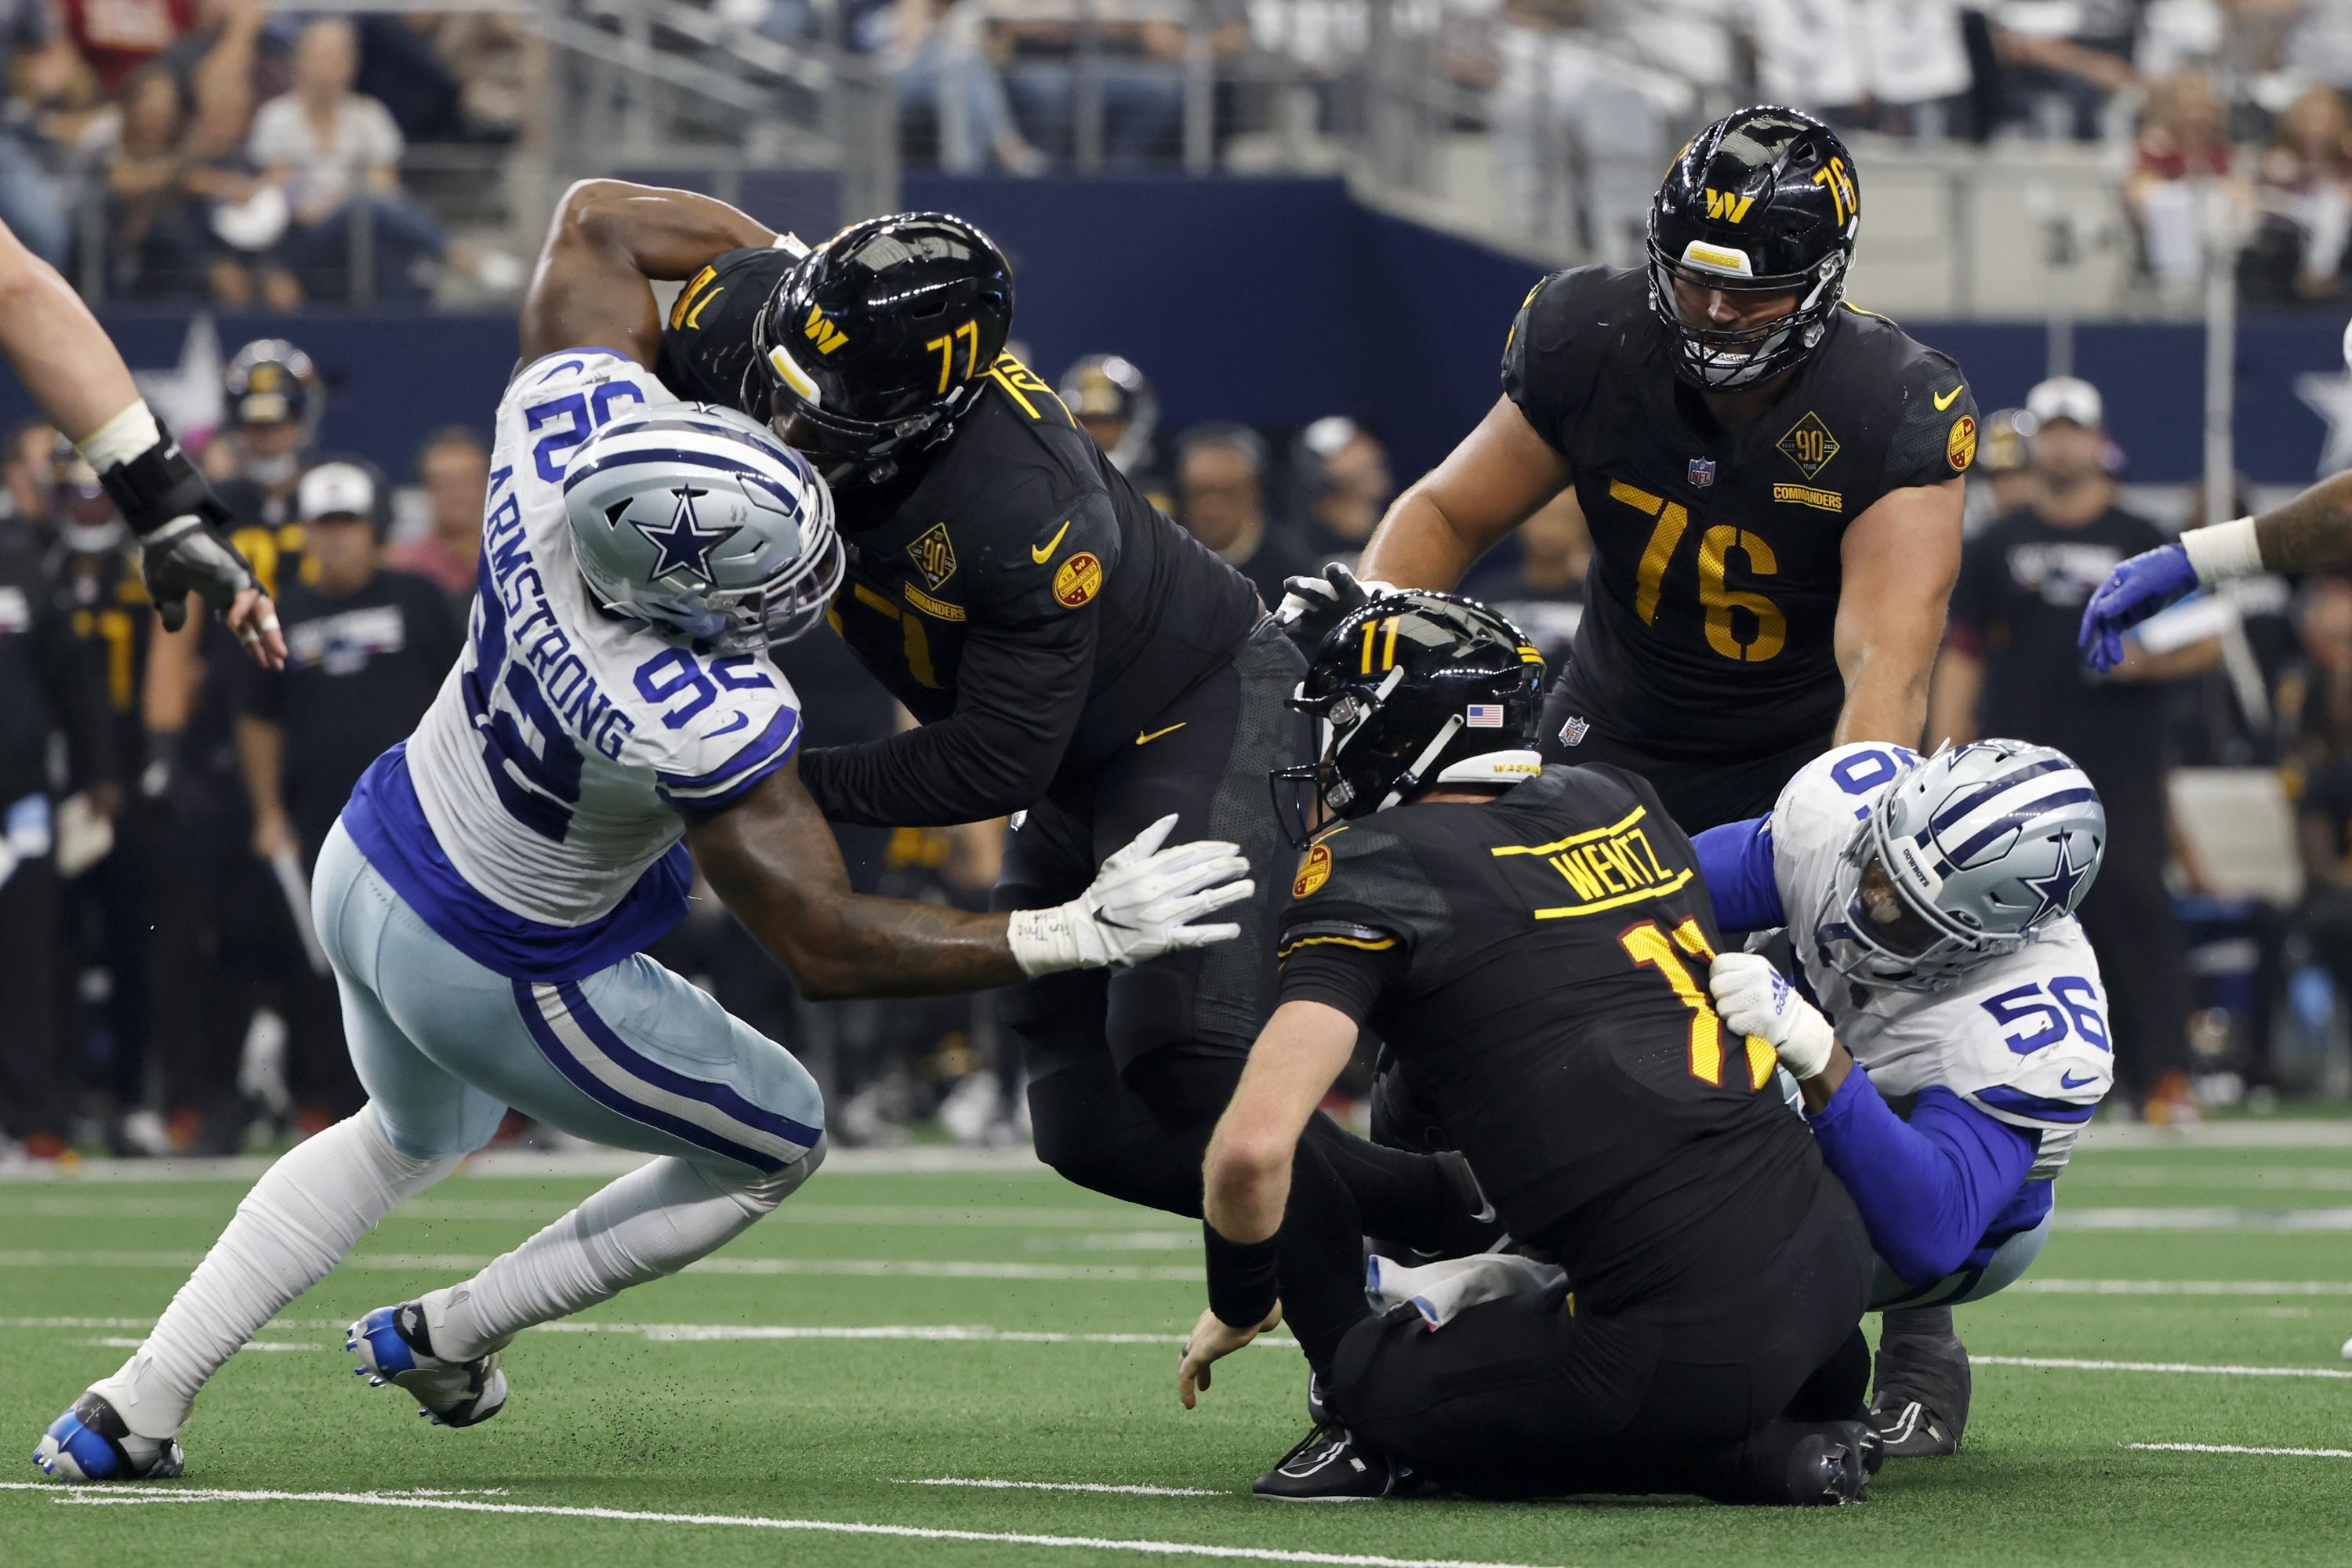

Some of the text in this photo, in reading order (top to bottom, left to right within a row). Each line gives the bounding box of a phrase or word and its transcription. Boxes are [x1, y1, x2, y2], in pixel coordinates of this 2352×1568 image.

[1705, 187, 1755, 224] W
[1811, 156, 1857, 227] 76
[804, 303, 849, 355] W
[927, 319, 978, 395] 77
[1795, 430, 1824, 462] 90
[1773, 486, 1842, 510] COMMANDERS
[923, 538, 948, 577] 90
[1059, 563, 1098, 597] COMMANDERS
[1610, 478, 1787, 662] 76
[487, 464, 635, 761] ARMSTRONG
[904, 583, 967, 619] COMMANDERS
[1361, 615, 1401, 675] 11
[633, 647, 777, 730] 92
[1548, 829, 1674, 902] WENTZ
[1903, 848, 1931, 887] COWBOYS
[1980, 975, 2111, 1056] 56
